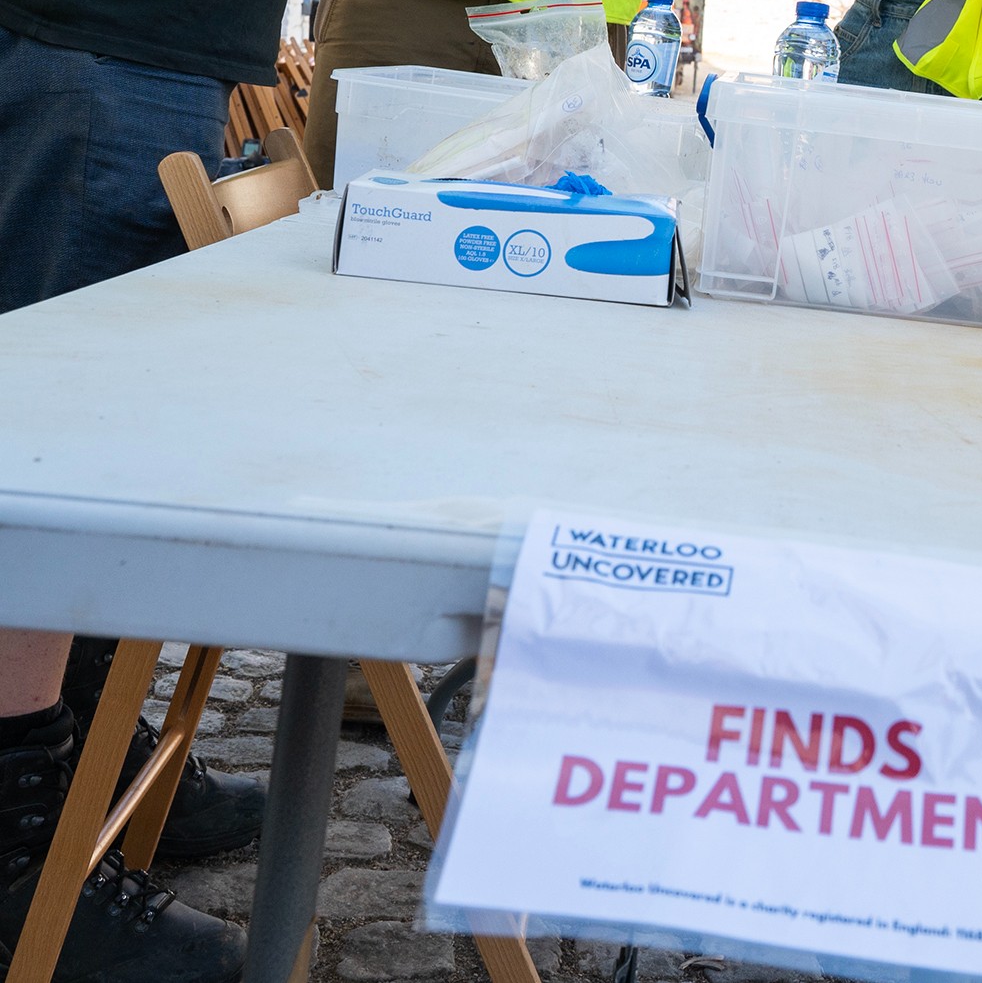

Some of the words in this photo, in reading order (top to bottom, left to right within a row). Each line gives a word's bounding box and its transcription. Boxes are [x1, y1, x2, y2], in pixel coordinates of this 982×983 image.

[627, 56, 651, 70] SPA
[352, 203, 432, 222] TouchGuard
[508, 245, 545, 258] XL/10
[570, 529, 722, 560] WATERLOO
[552, 551, 724, 589] UNCOVERED
[706, 704, 922, 781] FINDS
[580, 878, 644, 893] Waterloo
[648, 883, 722, 905] Uncovered
[752, 901, 798, 919] charity
[802, 908, 873, 927] registered
